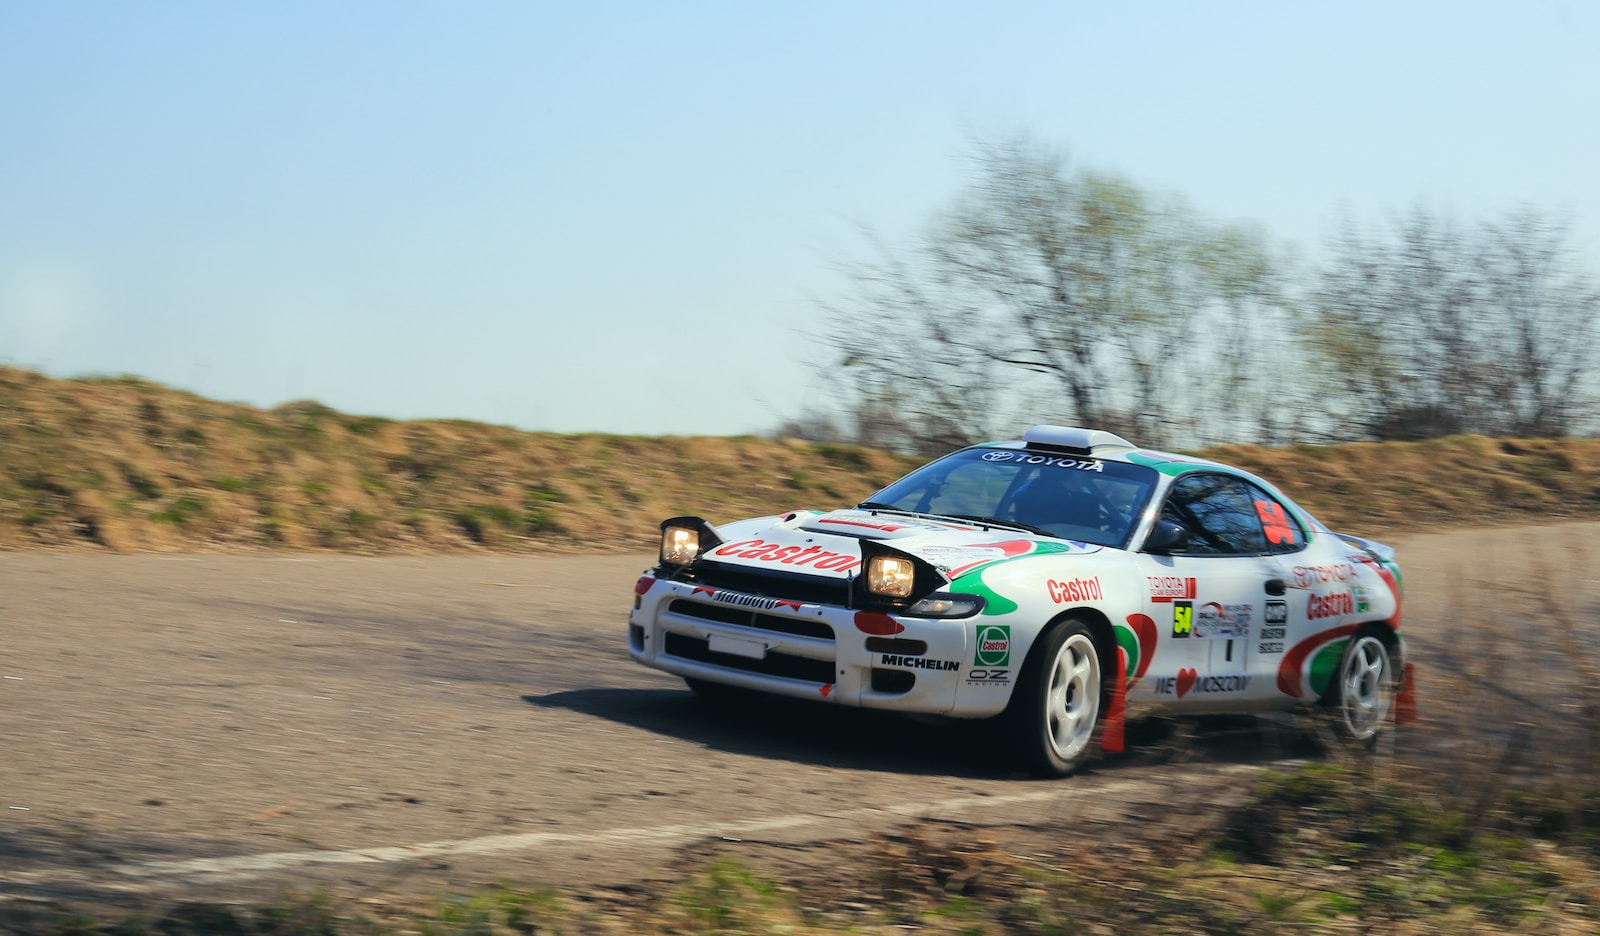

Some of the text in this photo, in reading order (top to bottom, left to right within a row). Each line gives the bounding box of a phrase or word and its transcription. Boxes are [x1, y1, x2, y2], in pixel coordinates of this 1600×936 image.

[1016, 454, 1104, 472] TOYOTA
[1253, 500, 1294, 544] 54
[715, 540, 861, 573] Castrol
[1147, 576, 1185, 589] TOYOTA
[1311, 565, 1356, 583] TOYOTA
[1047, 576, 1103, 604] Castrol
[1307, 591, 1354, 620] Castrol
[1174, 606, 1192, 634] 54
[982, 641, 1008, 651] Castrol
[881, 654, 960, 671] MICHELIN
[1155, 675, 1252, 694] WE MOSCOW
